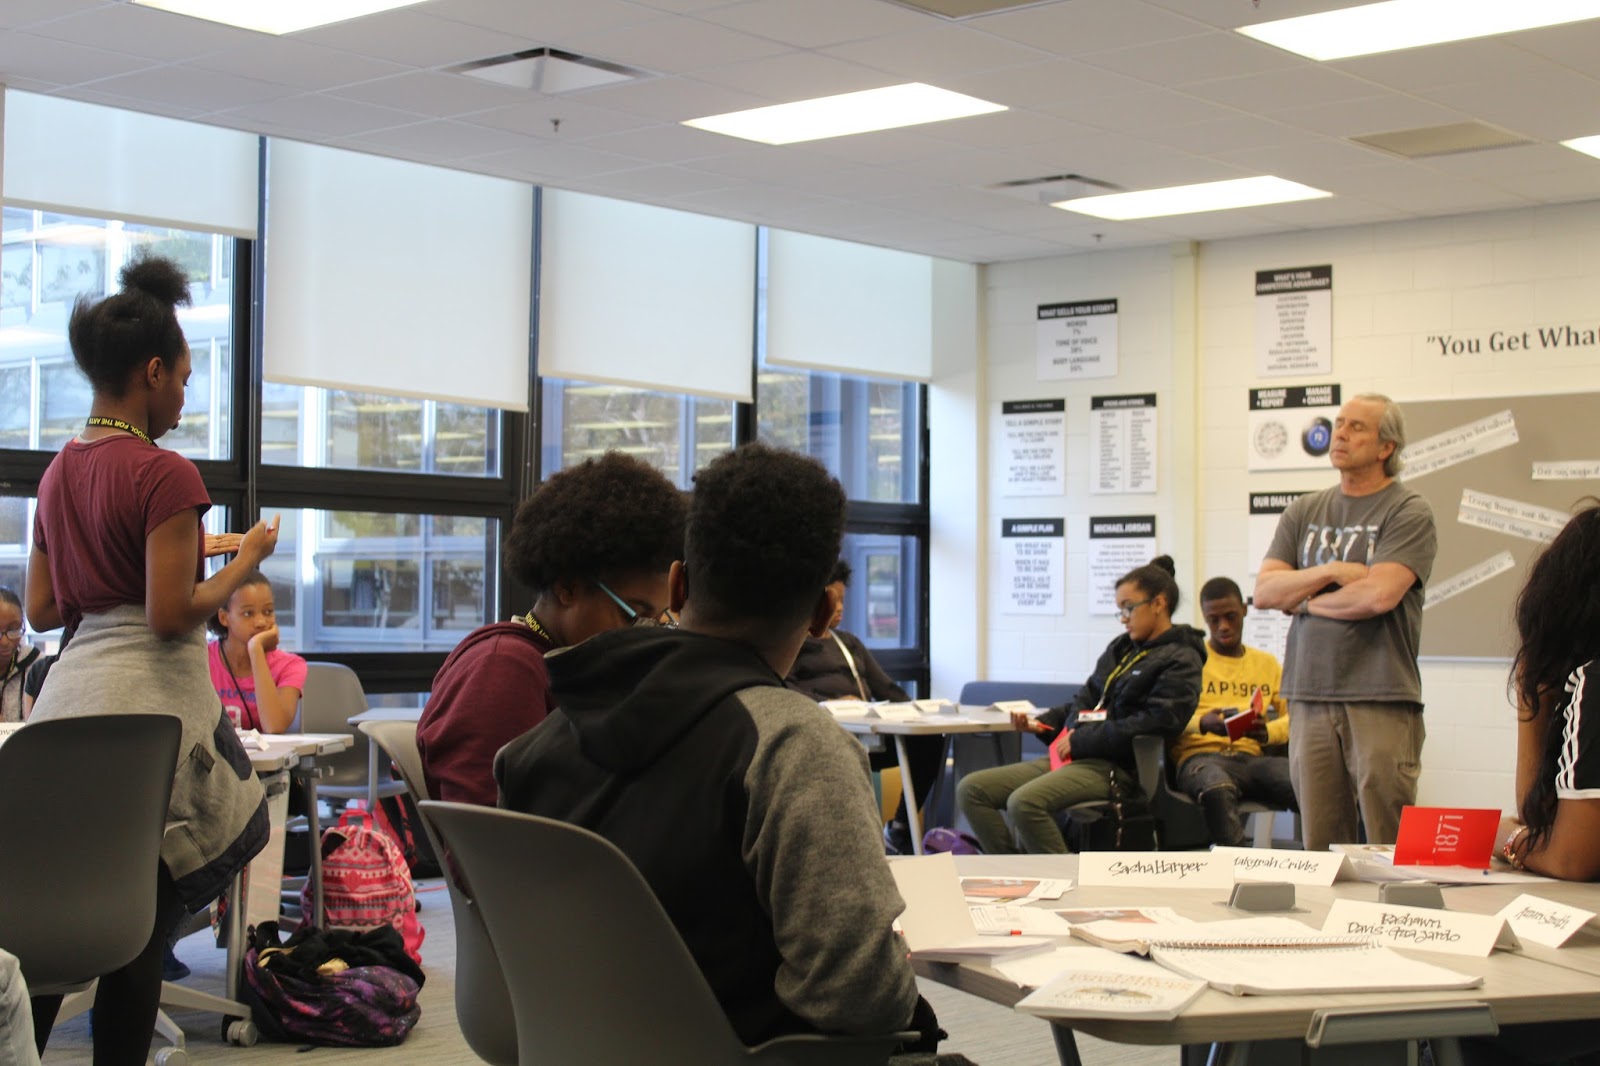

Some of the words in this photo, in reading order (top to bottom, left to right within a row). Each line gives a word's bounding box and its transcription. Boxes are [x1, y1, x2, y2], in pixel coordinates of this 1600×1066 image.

[1489, 331, 1530, 352] Get
[1538, 325, 1600, 348] Wha
[1258, 389, 1287, 399] MEASURE
[1306, 386, 1332, 396] MANAGE
[1307, 396, 1332, 405] CHANGE
[114, 421, 129, 429] FOR
[1253, 496, 1270, 508] OUR
[1271, 495, 1293, 507] DIALS
[1017, 524, 1038, 532] SIMPLE
[1038, 524, 1054, 532] PLAN
[1094, 524, 1124, 533] MICHAEL
[1124, 523, 1152, 532] JORDAN
[1303, 523, 1378, 566] 1871
[1202, 680, 1270, 696] AP1969
[1432, 814, 1463, 853] 1871
[1108, 861, 1154, 877] Sasha
[1154, 860, 1208, 879] Harper
[1381, 913, 1441, 928] Rashawn
